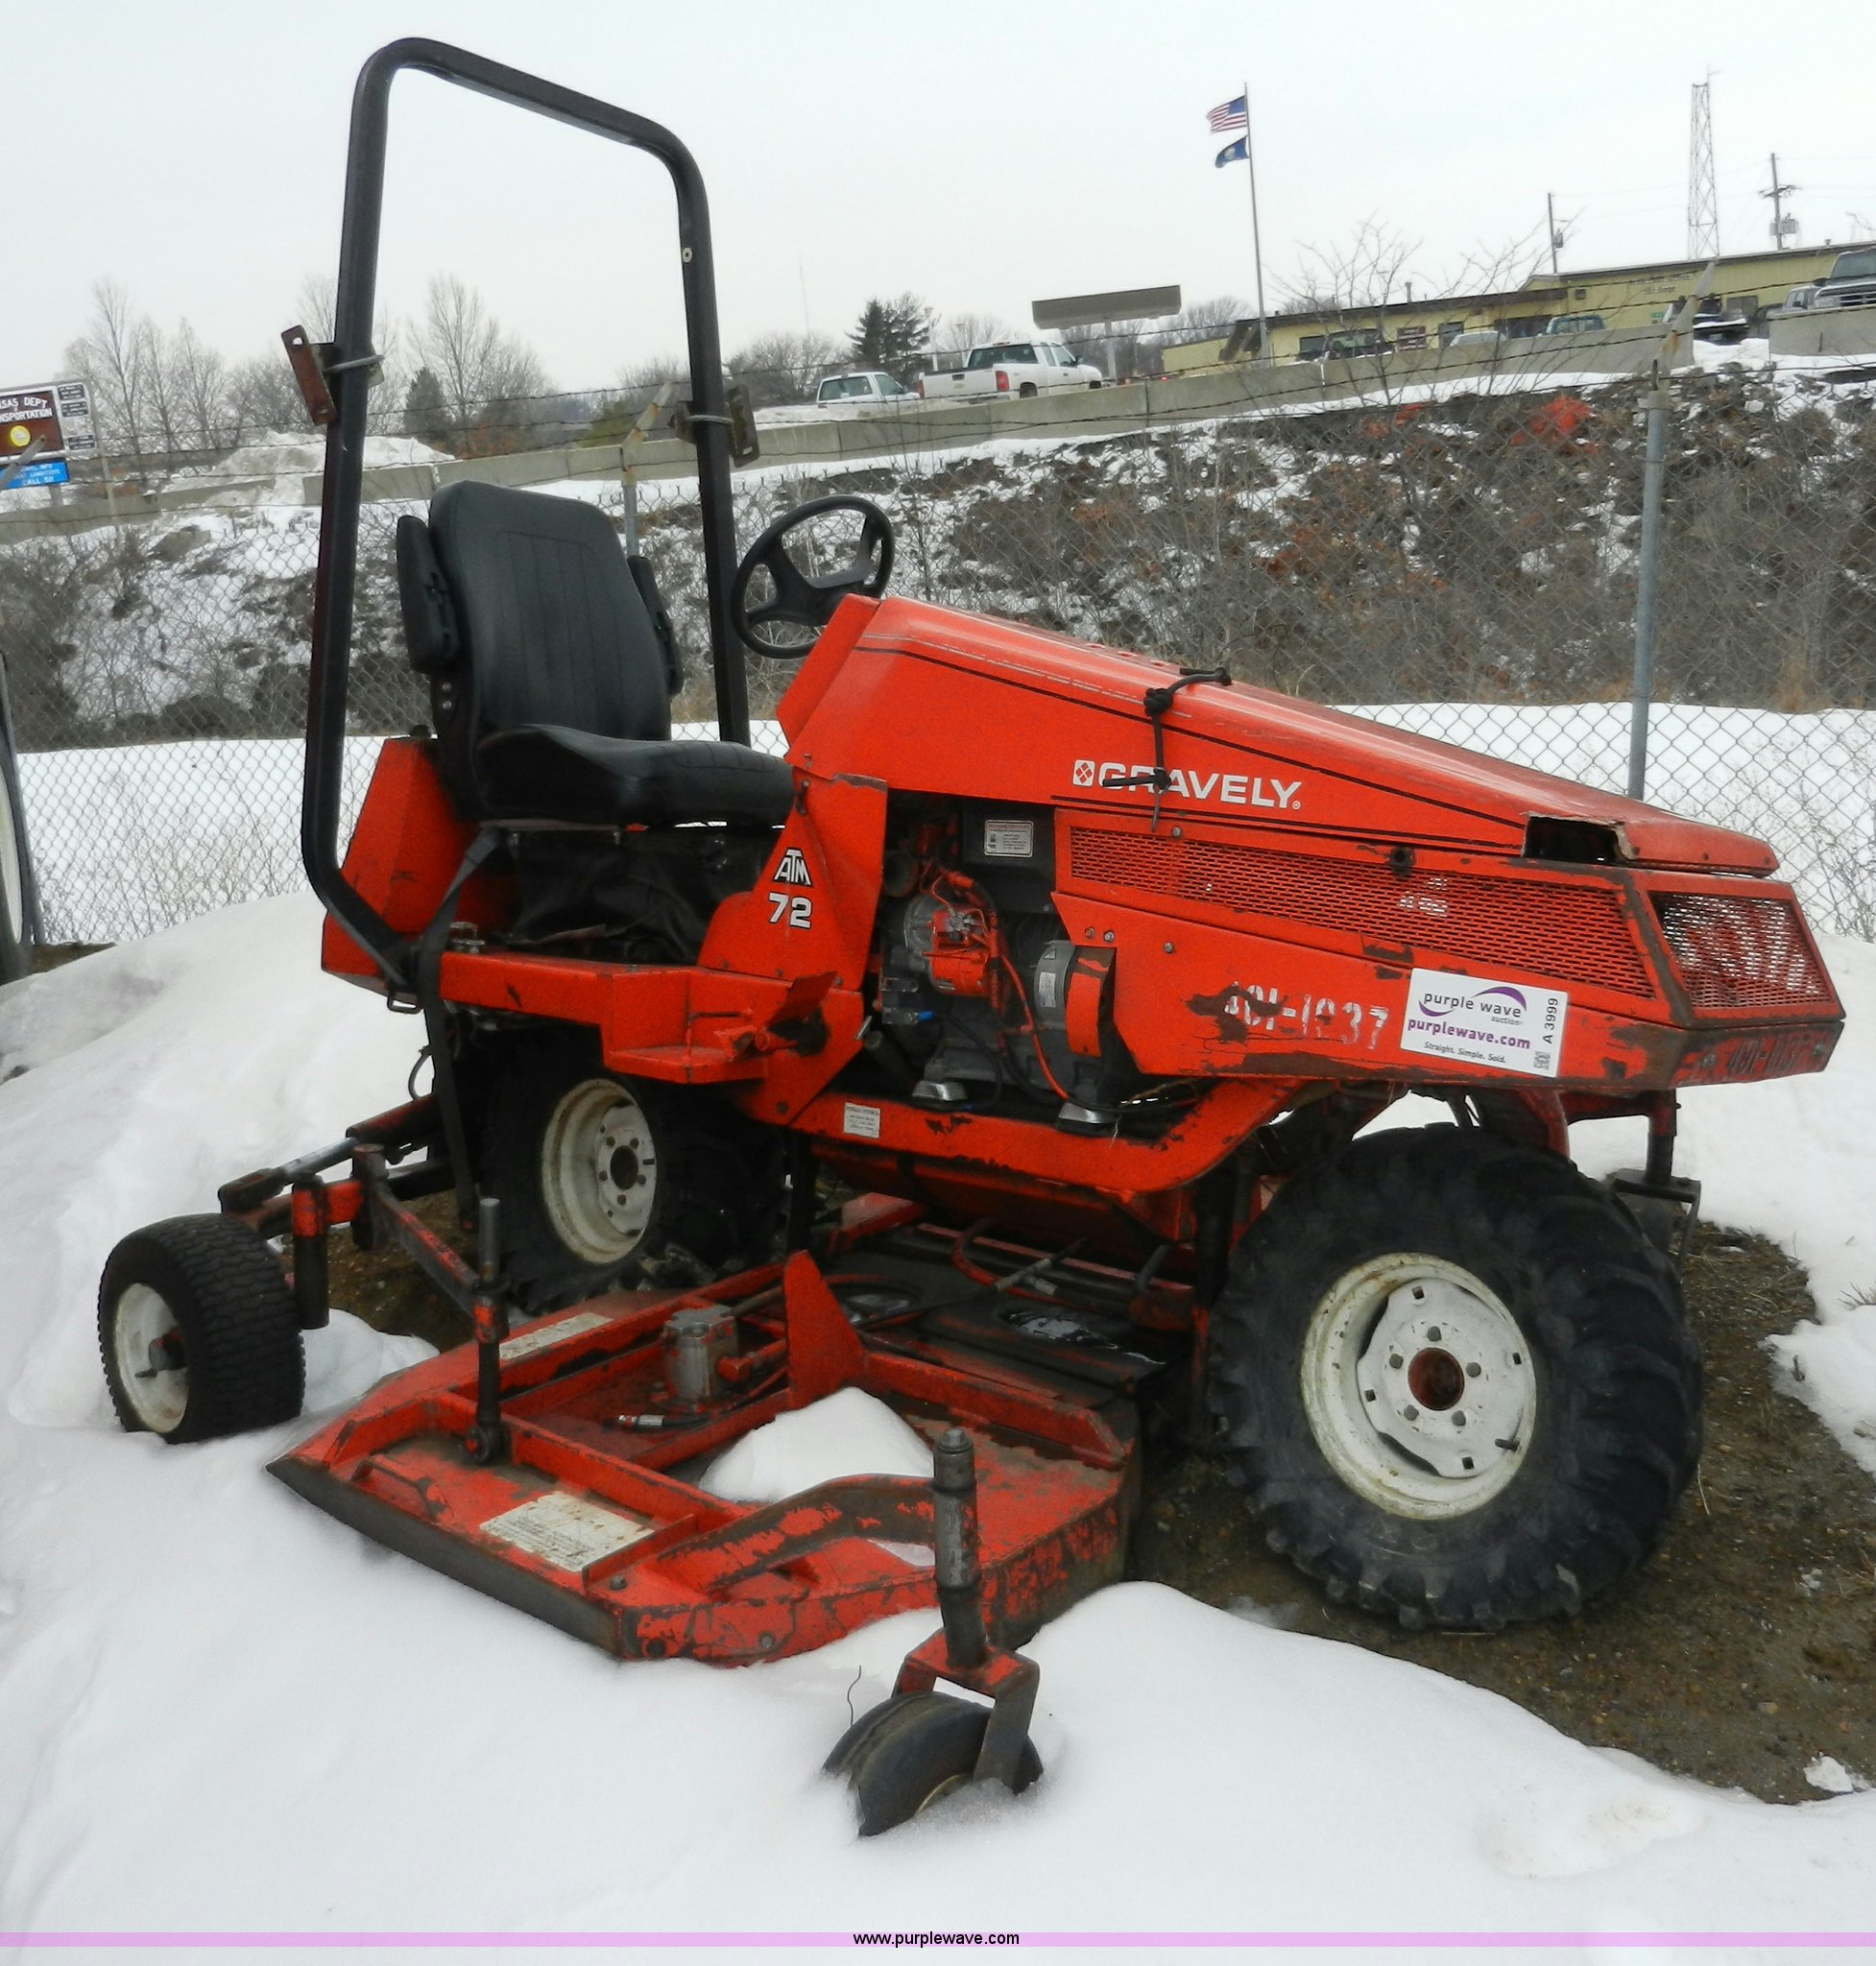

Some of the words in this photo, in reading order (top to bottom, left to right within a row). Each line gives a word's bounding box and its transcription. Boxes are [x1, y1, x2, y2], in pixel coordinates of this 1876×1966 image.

[0, 396, 19, 410] SAS
[24, 396, 48, 409] DEPT
[1098, 762, 1302, 809] GRAVELY
[773, 849, 812, 886] ATM
[769, 892, 812, 928] 72
[1424, 993, 1475, 1009] purple
[1480, 1001, 1522, 1018] wave
[1546, 997, 1558, 1031] 3999
[1407, 1018, 1530, 1049] purplewave.com
[1491, 1016, 1520, 1026] auction
[1424, 1041, 1455, 1055] Straight.
[1457, 1047, 1486, 1060] Simple.
[1542, 1034, 1553, 1044] A
